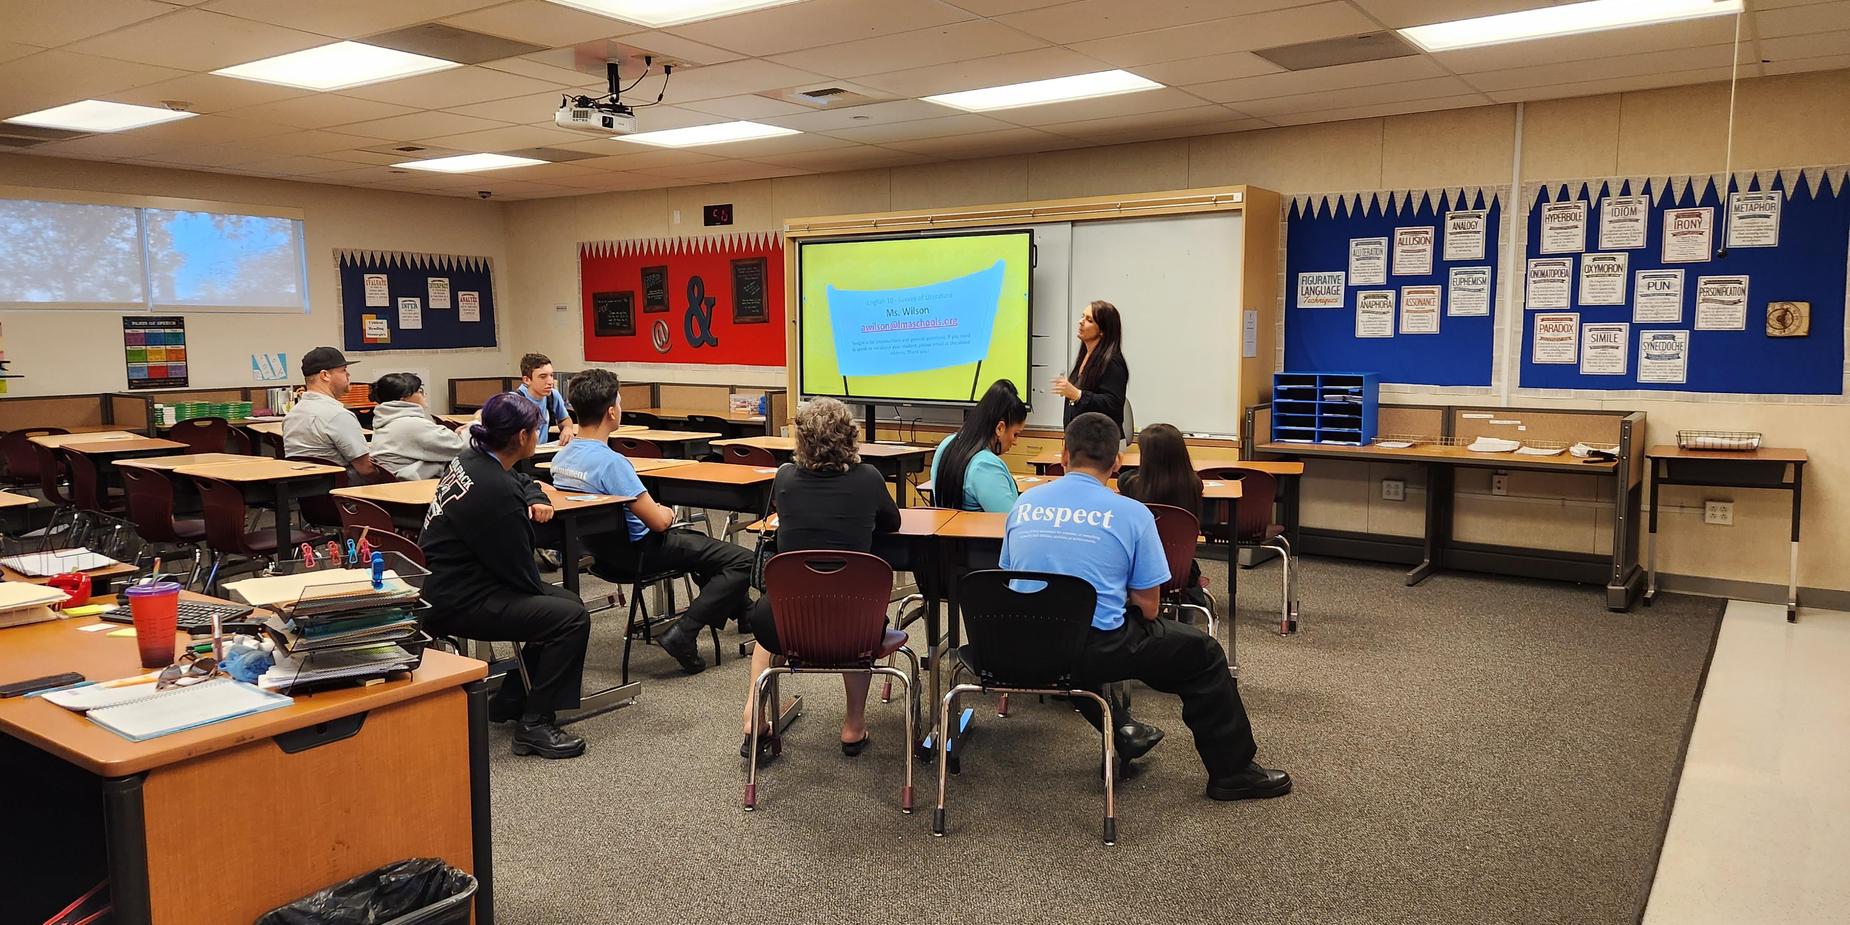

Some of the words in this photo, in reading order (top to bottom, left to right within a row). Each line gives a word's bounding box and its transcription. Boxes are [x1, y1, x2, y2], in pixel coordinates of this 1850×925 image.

[1611, 207, 1637, 217] IDIOM
[1734, 203, 1776, 212] METAPHOR
[1545, 212, 1582, 223] HYPERBOLE
[1453, 221, 1478, 230] ANALOGY
[1674, 219, 1703, 230] IRONY
[1398, 236, 1431, 246] ALLUSION
[1531, 269, 1569, 278] ONOMATOPOEIA
[1585, 264, 1623, 273] OXYMORON
[1301, 275, 1342, 285] FIGURATIVE
[1453, 277, 1487, 287] EUPHEMISM
[1301, 285, 1340, 296] LANGUAGE
[1647, 280, 1670, 291] PUN
[1700, 286, 1746, 297] PERSONIFICATION
[1360, 300, 1392, 309] ANAPHORA
[1405, 298, 1436, 307] ASSONANCE
[886, 308, 900, 318] Ms.
[902, 306, 930, 316] Wilson
[1539, 323, 1574, 333] PARADOX
[1591, 334, 1618, 343] SIMILE
[1642, 341, 1683, 351] SYNECDOCHE
[1016, 503, 1114, 528] Respect
